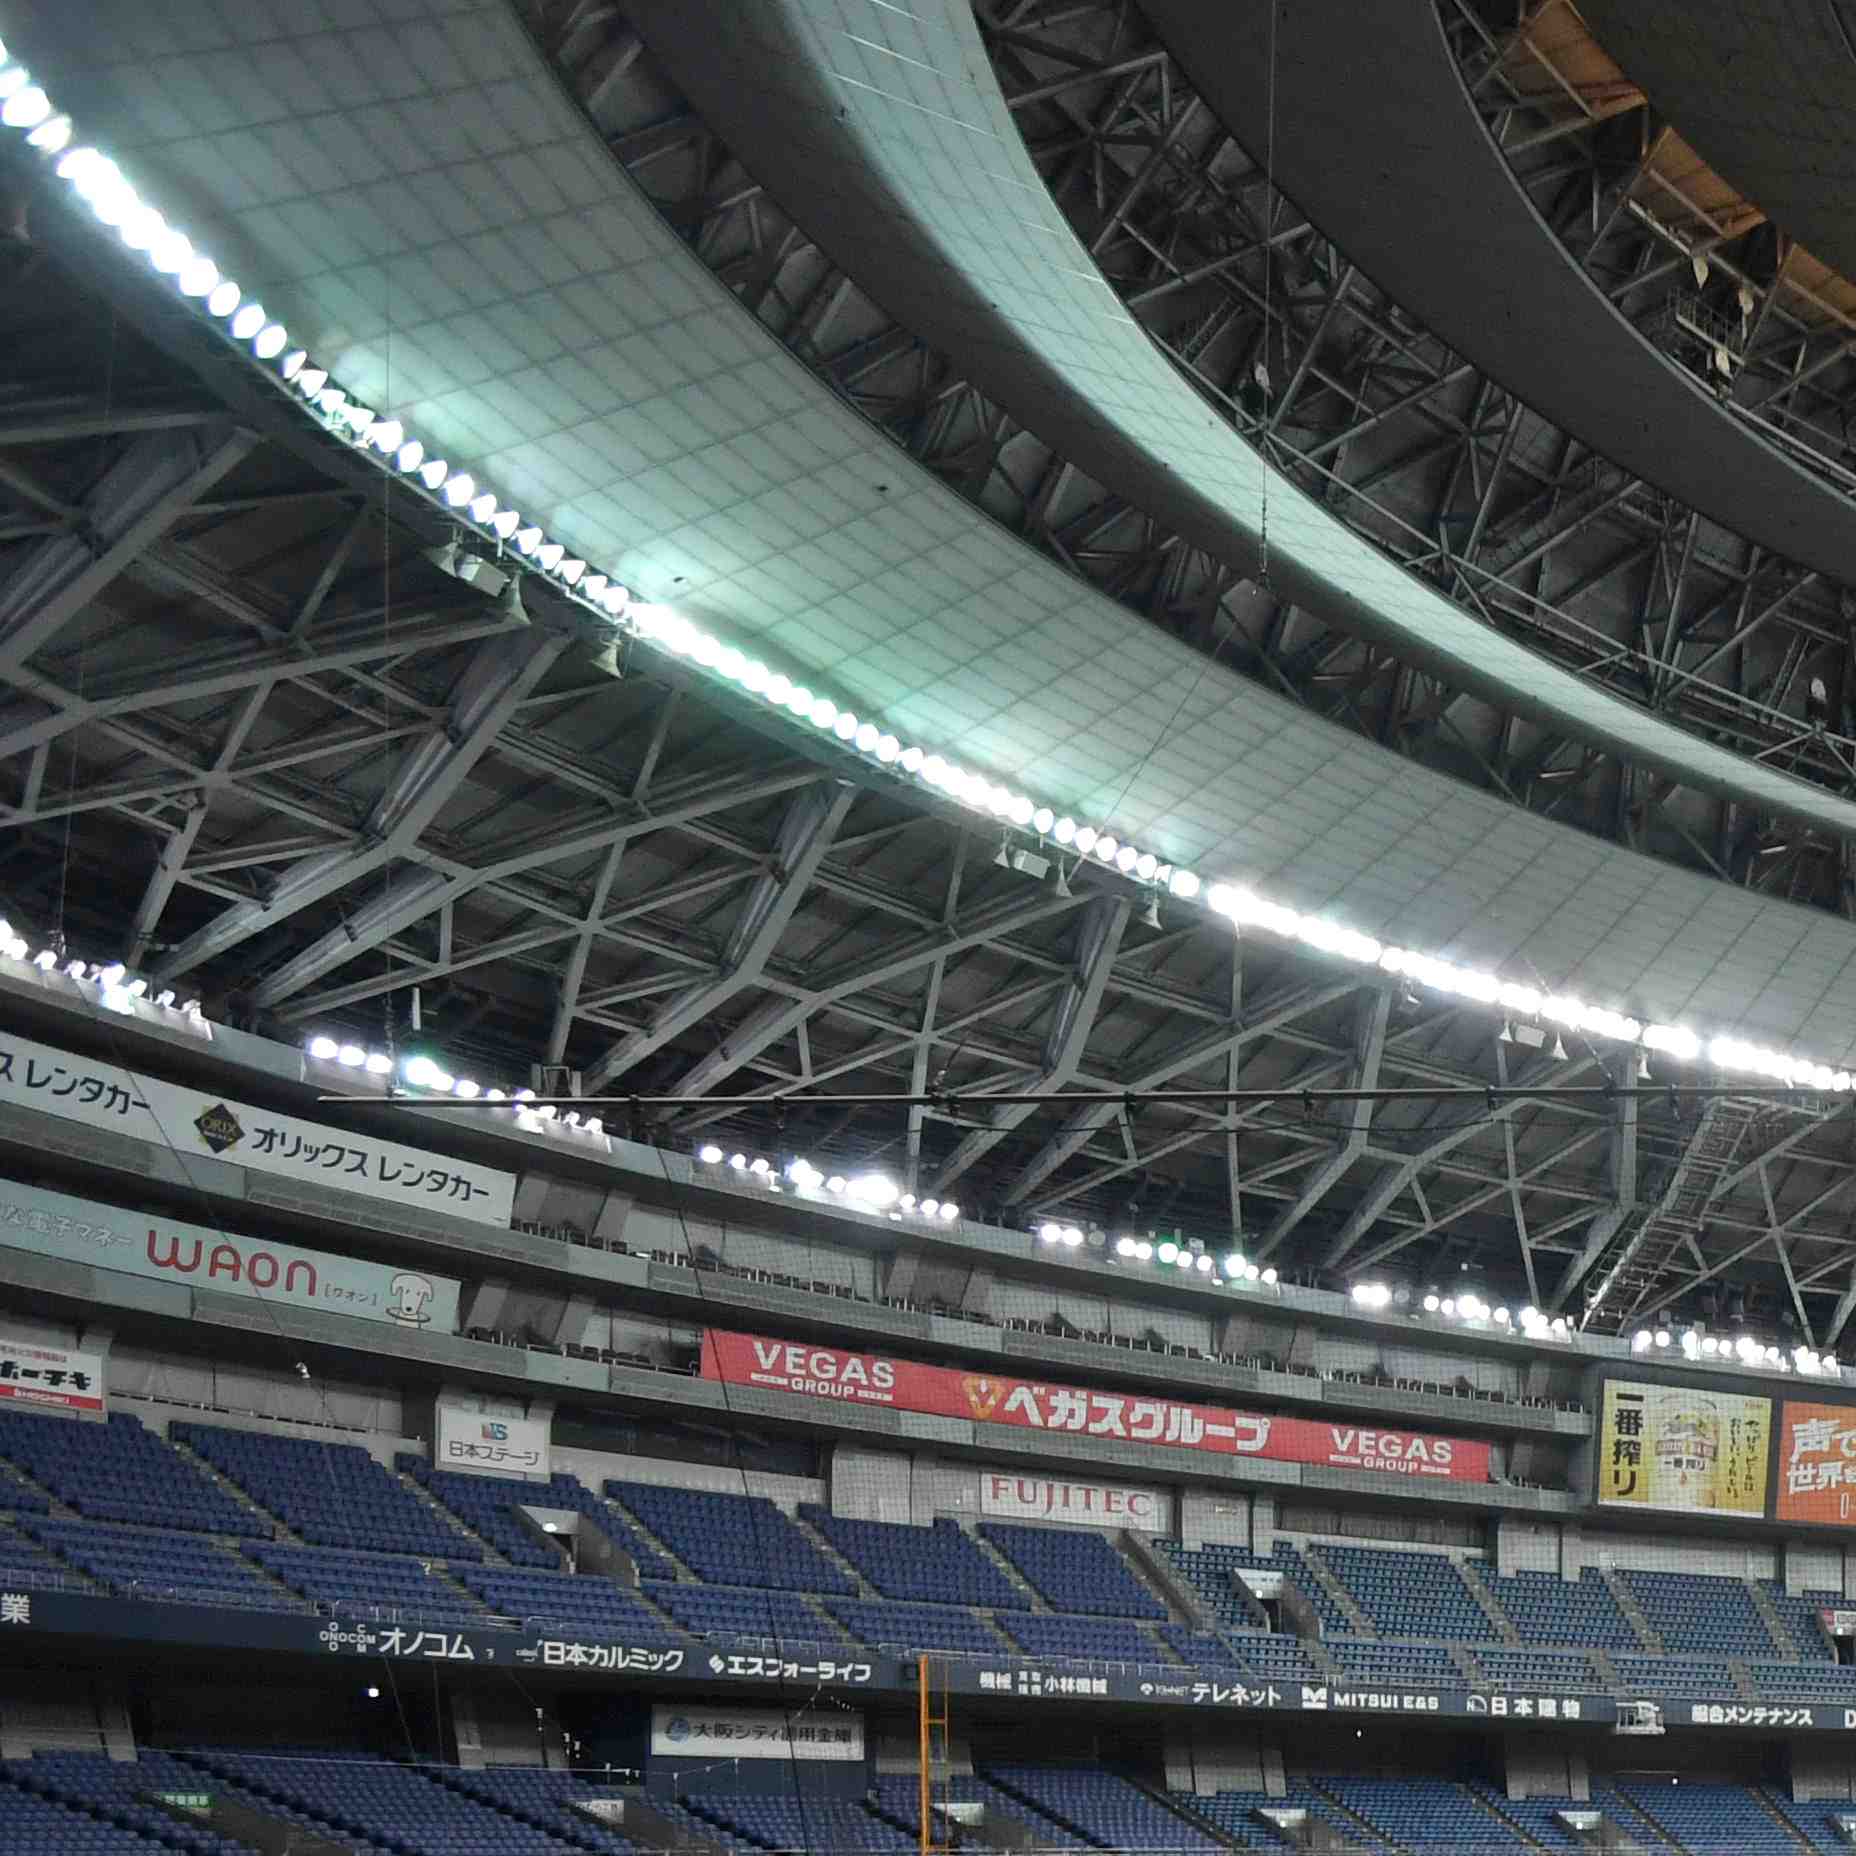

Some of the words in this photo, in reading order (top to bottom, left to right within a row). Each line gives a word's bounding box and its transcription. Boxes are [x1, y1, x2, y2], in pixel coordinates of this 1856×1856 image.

[26, 1058, 150, 1114] レンタカー
[253, 1128, 368, 1177] オリックス
[379, 1155, 490, 1200] レンタカー
[147, 1229, 317, 1296] WAON
[753, 1341, 895, 1388] VEGAS
[789, 1377, 855, 1398] GROUP
[1004, 1384, 1272, 1453] ベガスグループ
[449, 1440, 539, 1466] 日本ステージ
[1330, 1428, 1452, 1463] VEGAS
[1613, 1392, 1644, 1496] 一番搾り
[1363, 1457, 1418, 1474] GROUP
[991, 1475, 1151, 1517] FUJITEC
[378, 1626, 475, 1660] オノコム
[544, 1641, 684, 1672] 日本カルミック
[727, 1654, 871, 1682] エスフォーライフ
[1192, 1682, 1281, 1707] テレネット
[1334, 1693, 1399, 1709] MITSUI
